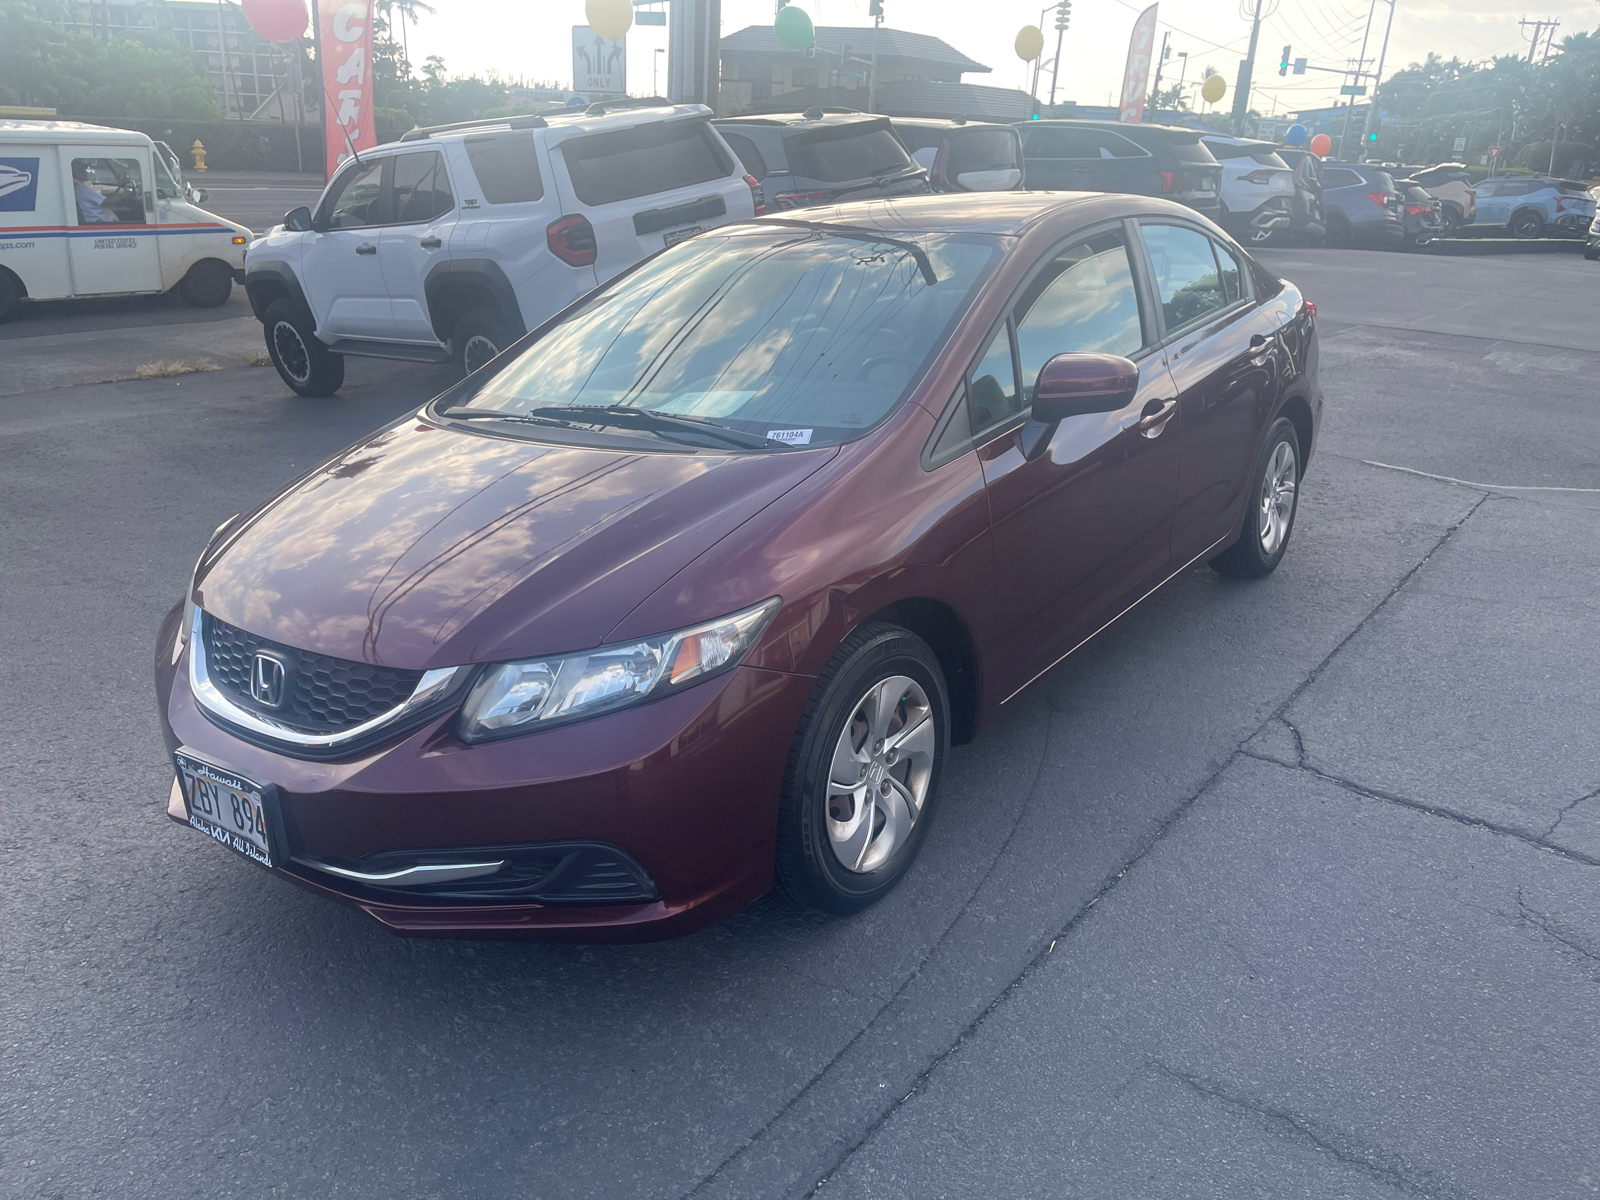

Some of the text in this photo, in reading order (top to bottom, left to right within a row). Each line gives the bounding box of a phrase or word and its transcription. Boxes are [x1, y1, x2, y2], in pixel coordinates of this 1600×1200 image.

[587, 77, 611, 88] ONLY
[198, 766, 242, 791] Hawaii
[184, 773, 222, 821] ZBY
[230, 793, 267, 844] 894
[190, 814, 210, 835] Aloha
[233, 837, 244, 853] All
